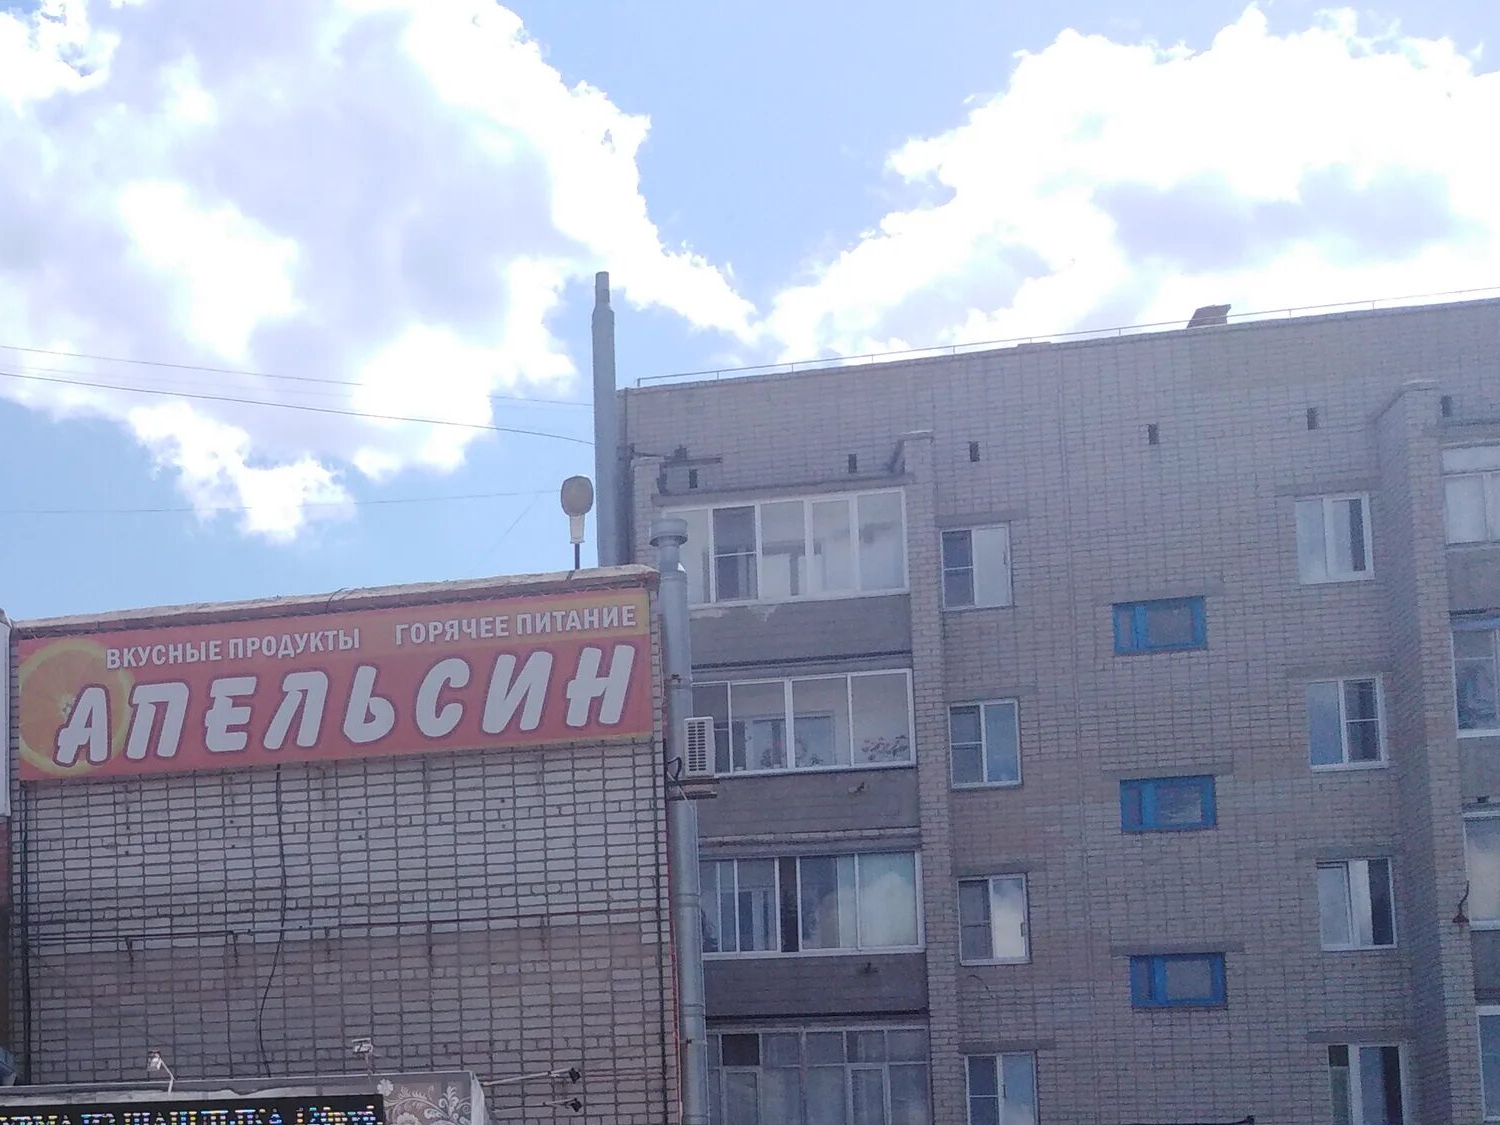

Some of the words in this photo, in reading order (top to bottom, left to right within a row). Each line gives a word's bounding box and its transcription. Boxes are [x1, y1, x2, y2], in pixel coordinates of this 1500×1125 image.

[106, 639, 222, 669] ВКУСНЫЕ
[228, 627, 361, 658] ПРОДУКТЫ
[395, 619, 509, 647] ГОРЯЧЕЕ
[516, 605, 636, 636] ПИТАНИЕ
[55, 644, 636, 766] АПЕЛЬСИН
